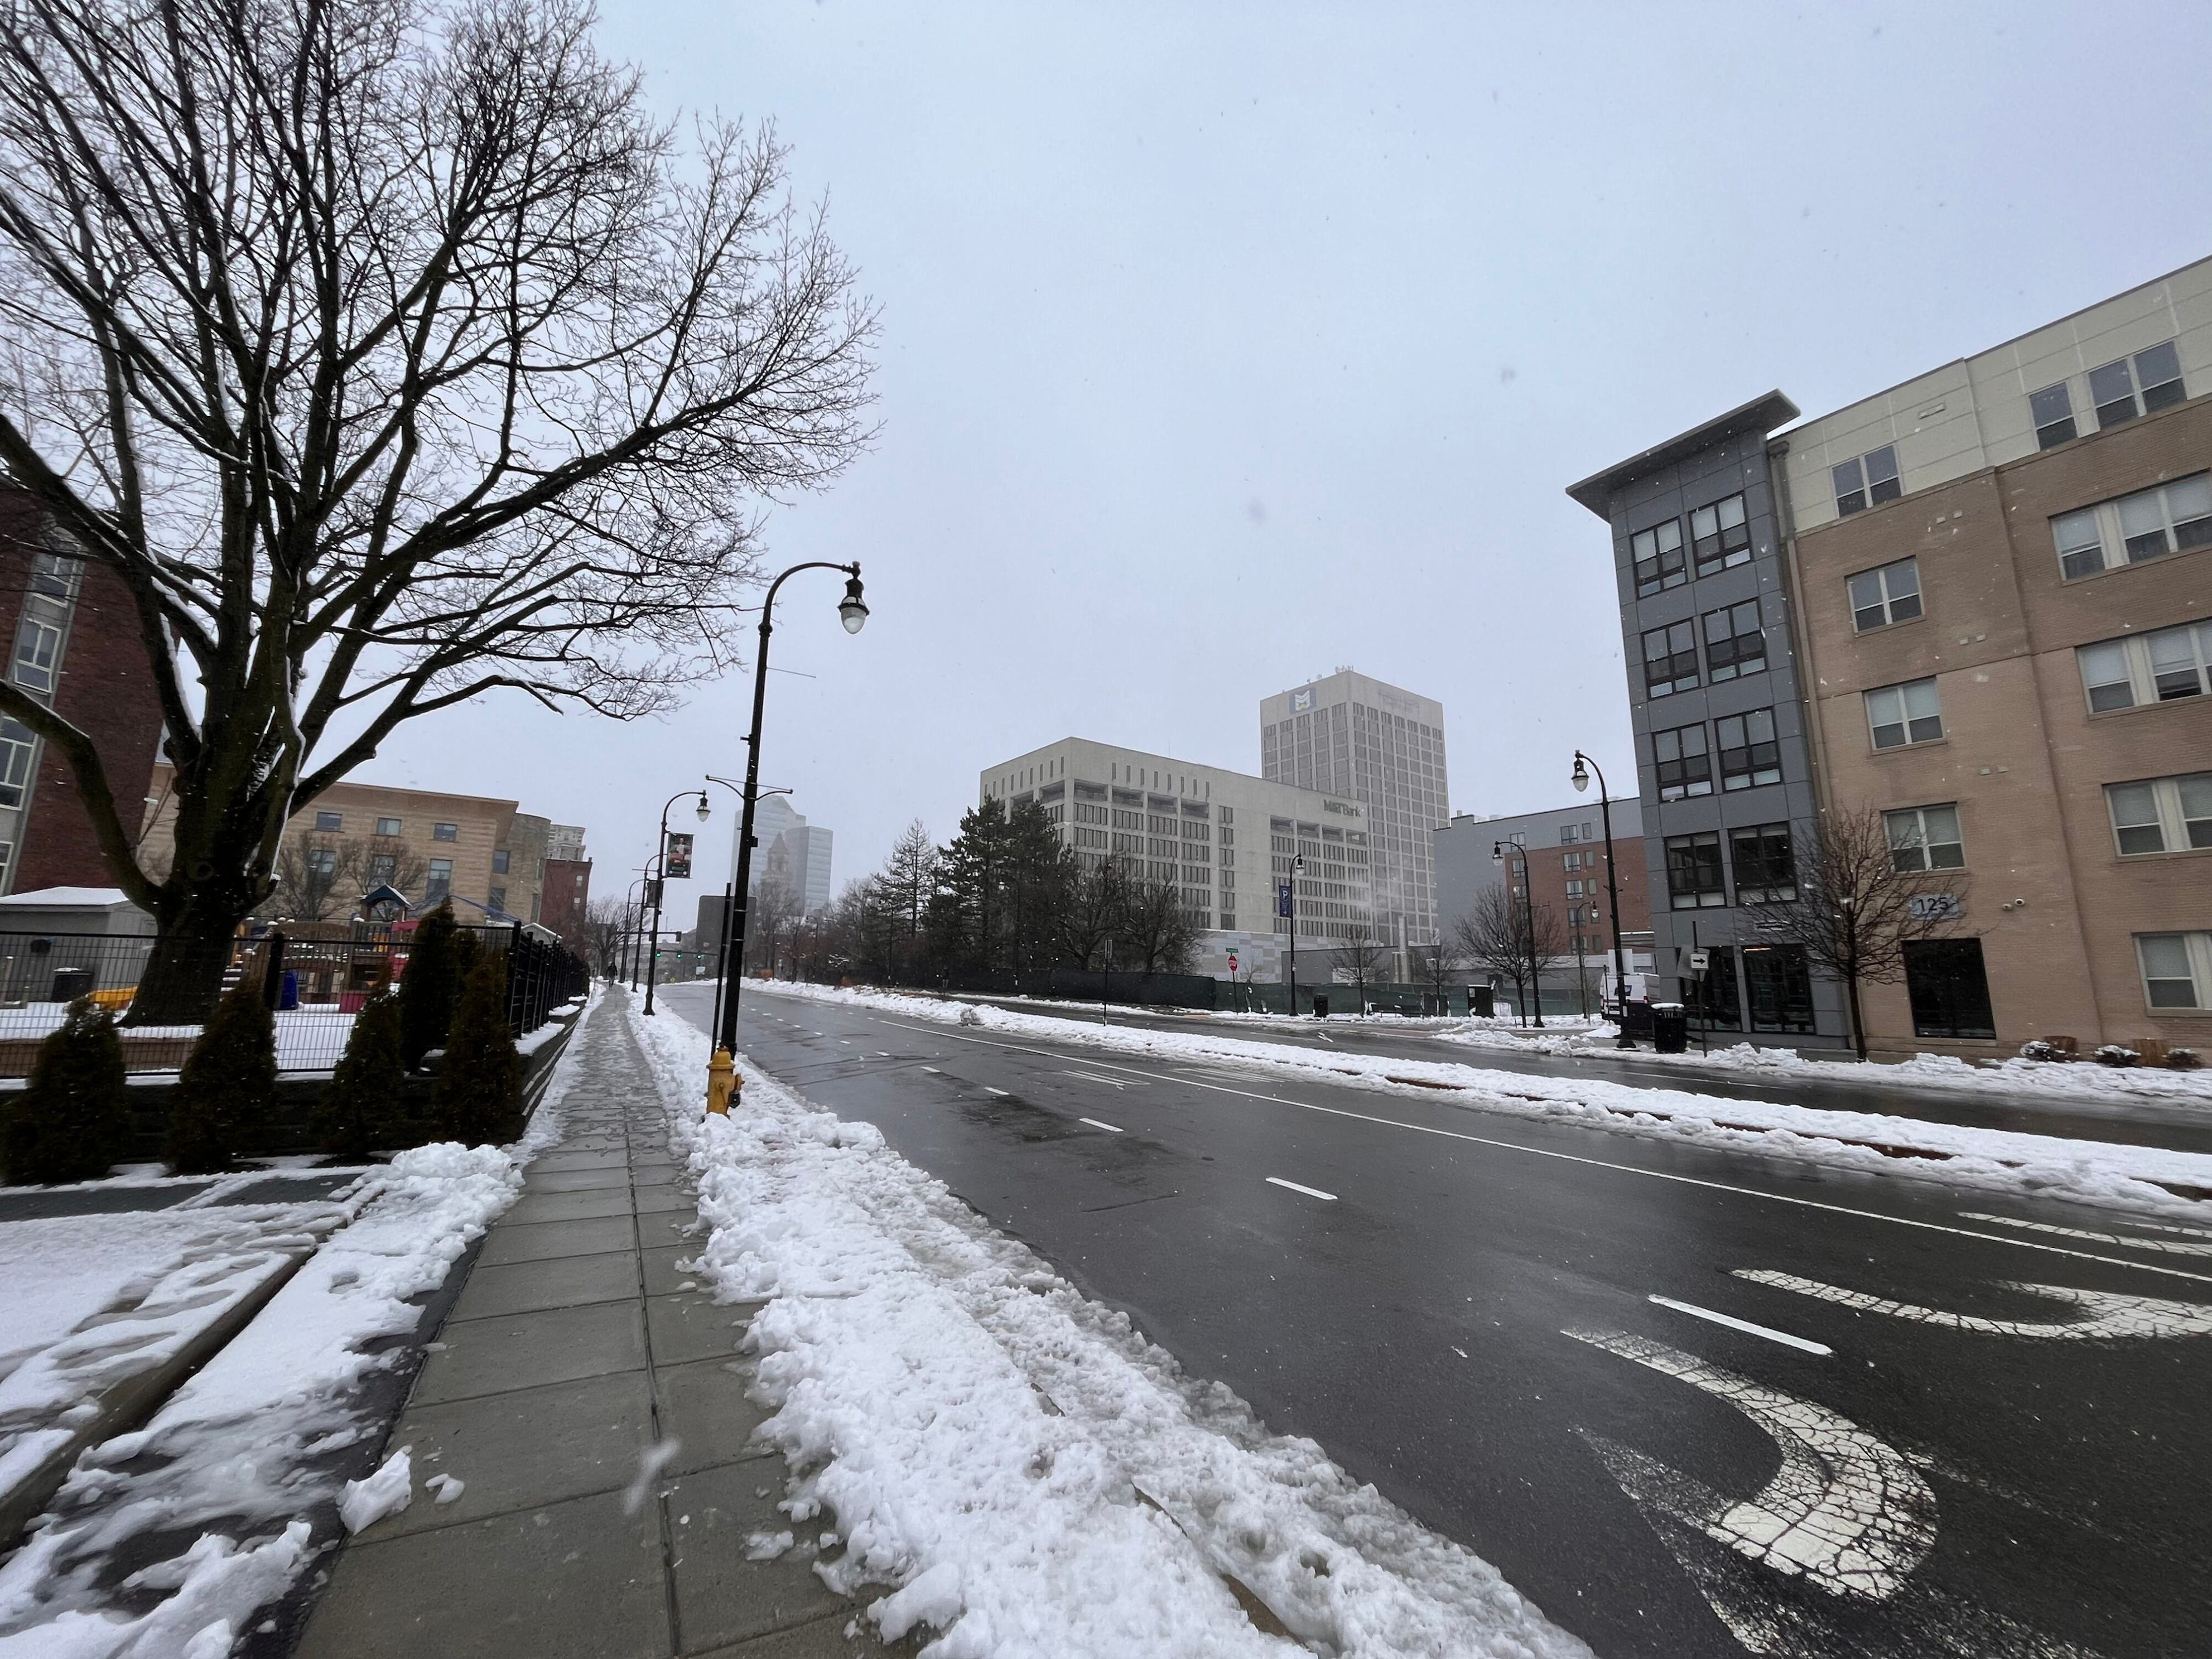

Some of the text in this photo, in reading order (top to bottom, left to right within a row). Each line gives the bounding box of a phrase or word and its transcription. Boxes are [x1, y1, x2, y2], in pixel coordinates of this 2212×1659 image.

[1342, 803, 1361, 817] Bank
[1283, 890, 1288, 899] P
[1918, 897, 1949, 912] 125
